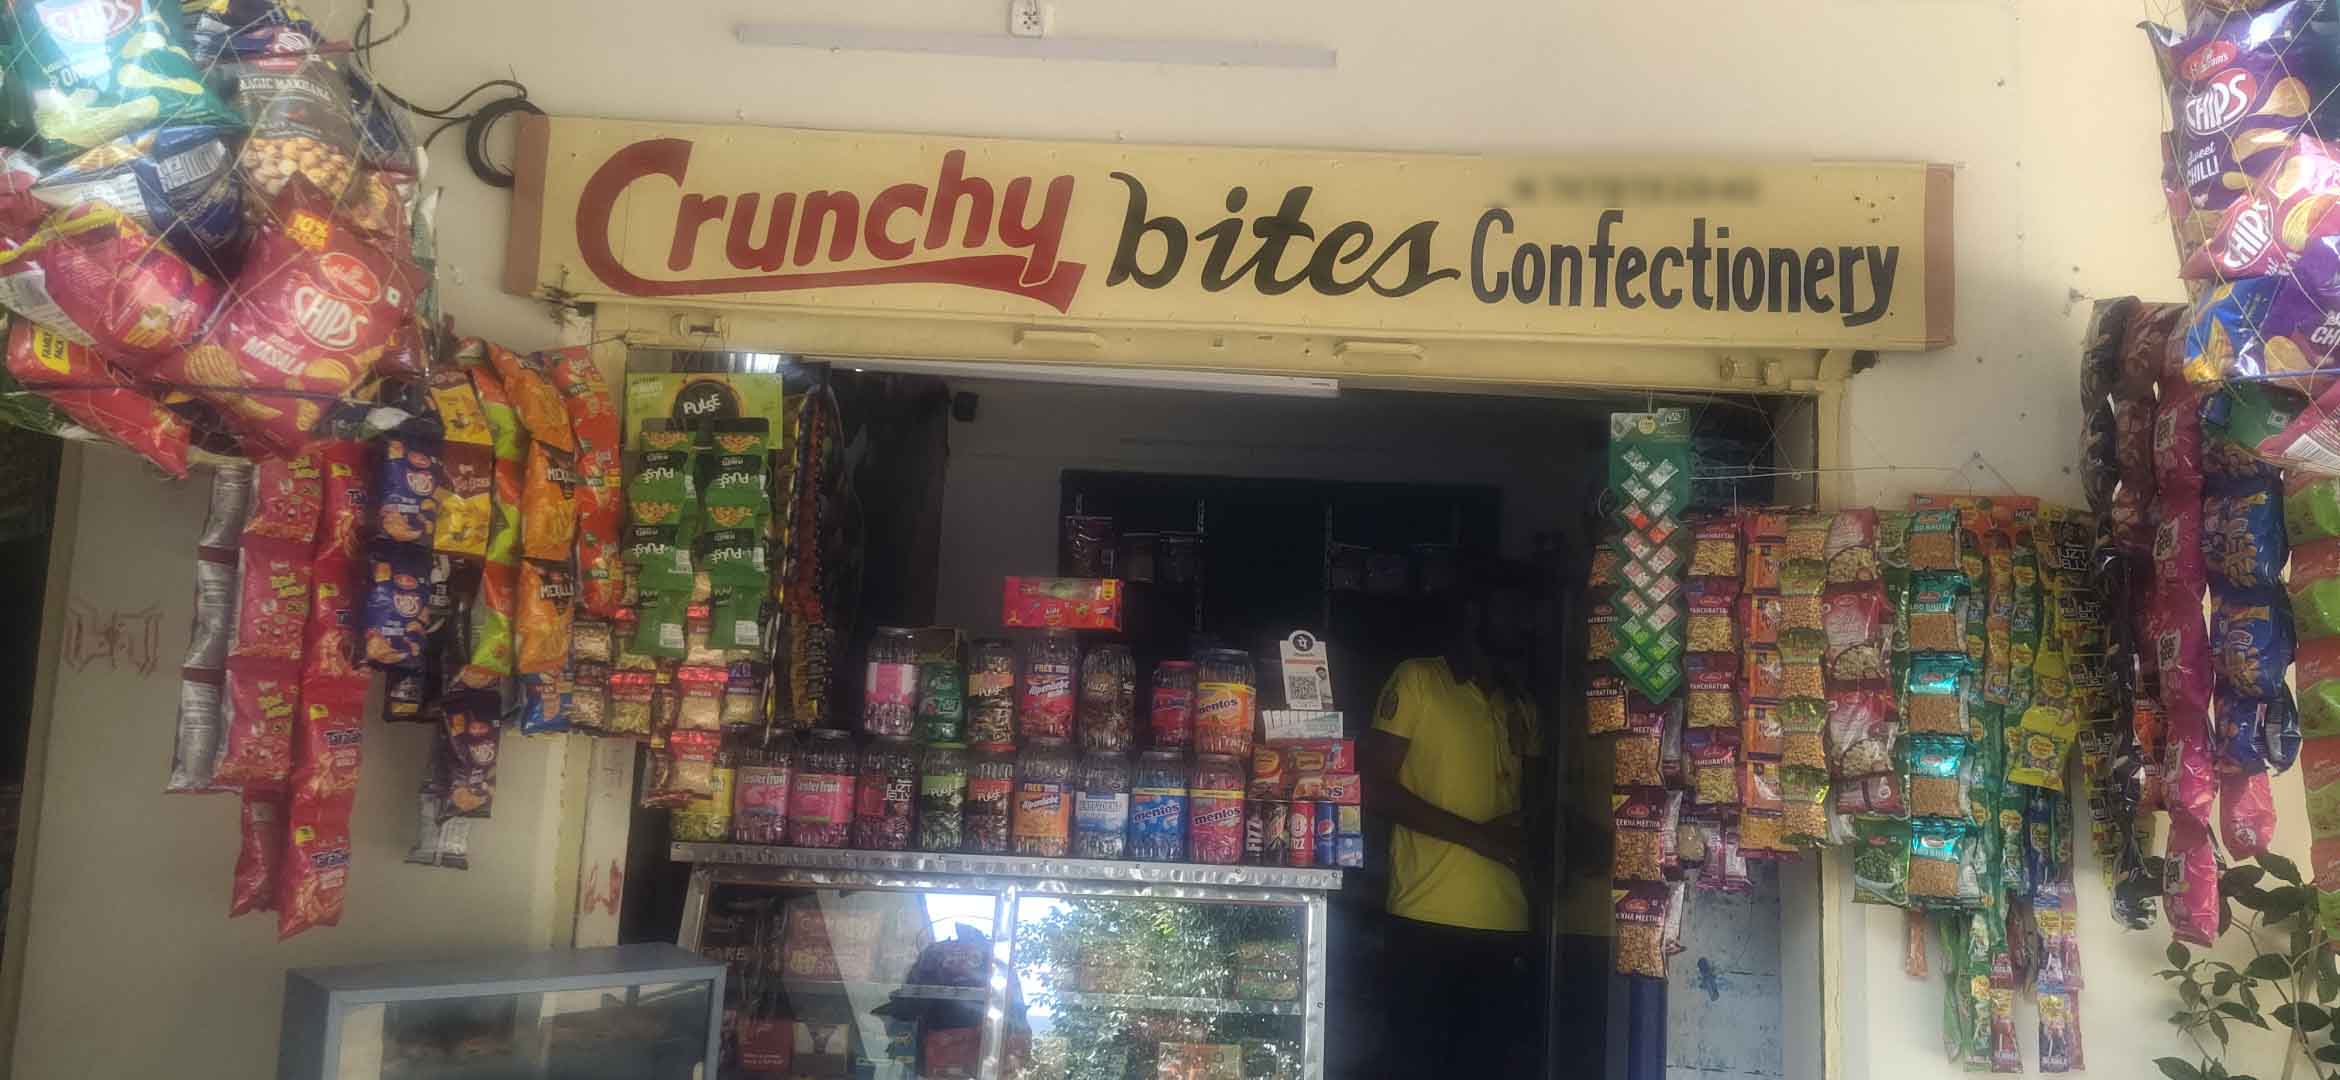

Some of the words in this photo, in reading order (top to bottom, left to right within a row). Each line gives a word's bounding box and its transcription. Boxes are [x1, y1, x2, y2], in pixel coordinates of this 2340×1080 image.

[2185, 73, 2248, 130] CHIPS
[575, 137, 1088, 314] Crunchy
[1105, 170, 1462, 298] bites
[1470, 206, 1899, 328] Confectionery
[294, 286, 369, 346] CHIPS
[683, 393, 721, 415] PULSE
[1134, 802, 1180, 822] mentos
[1194, 806, 1241, 826] mentos
